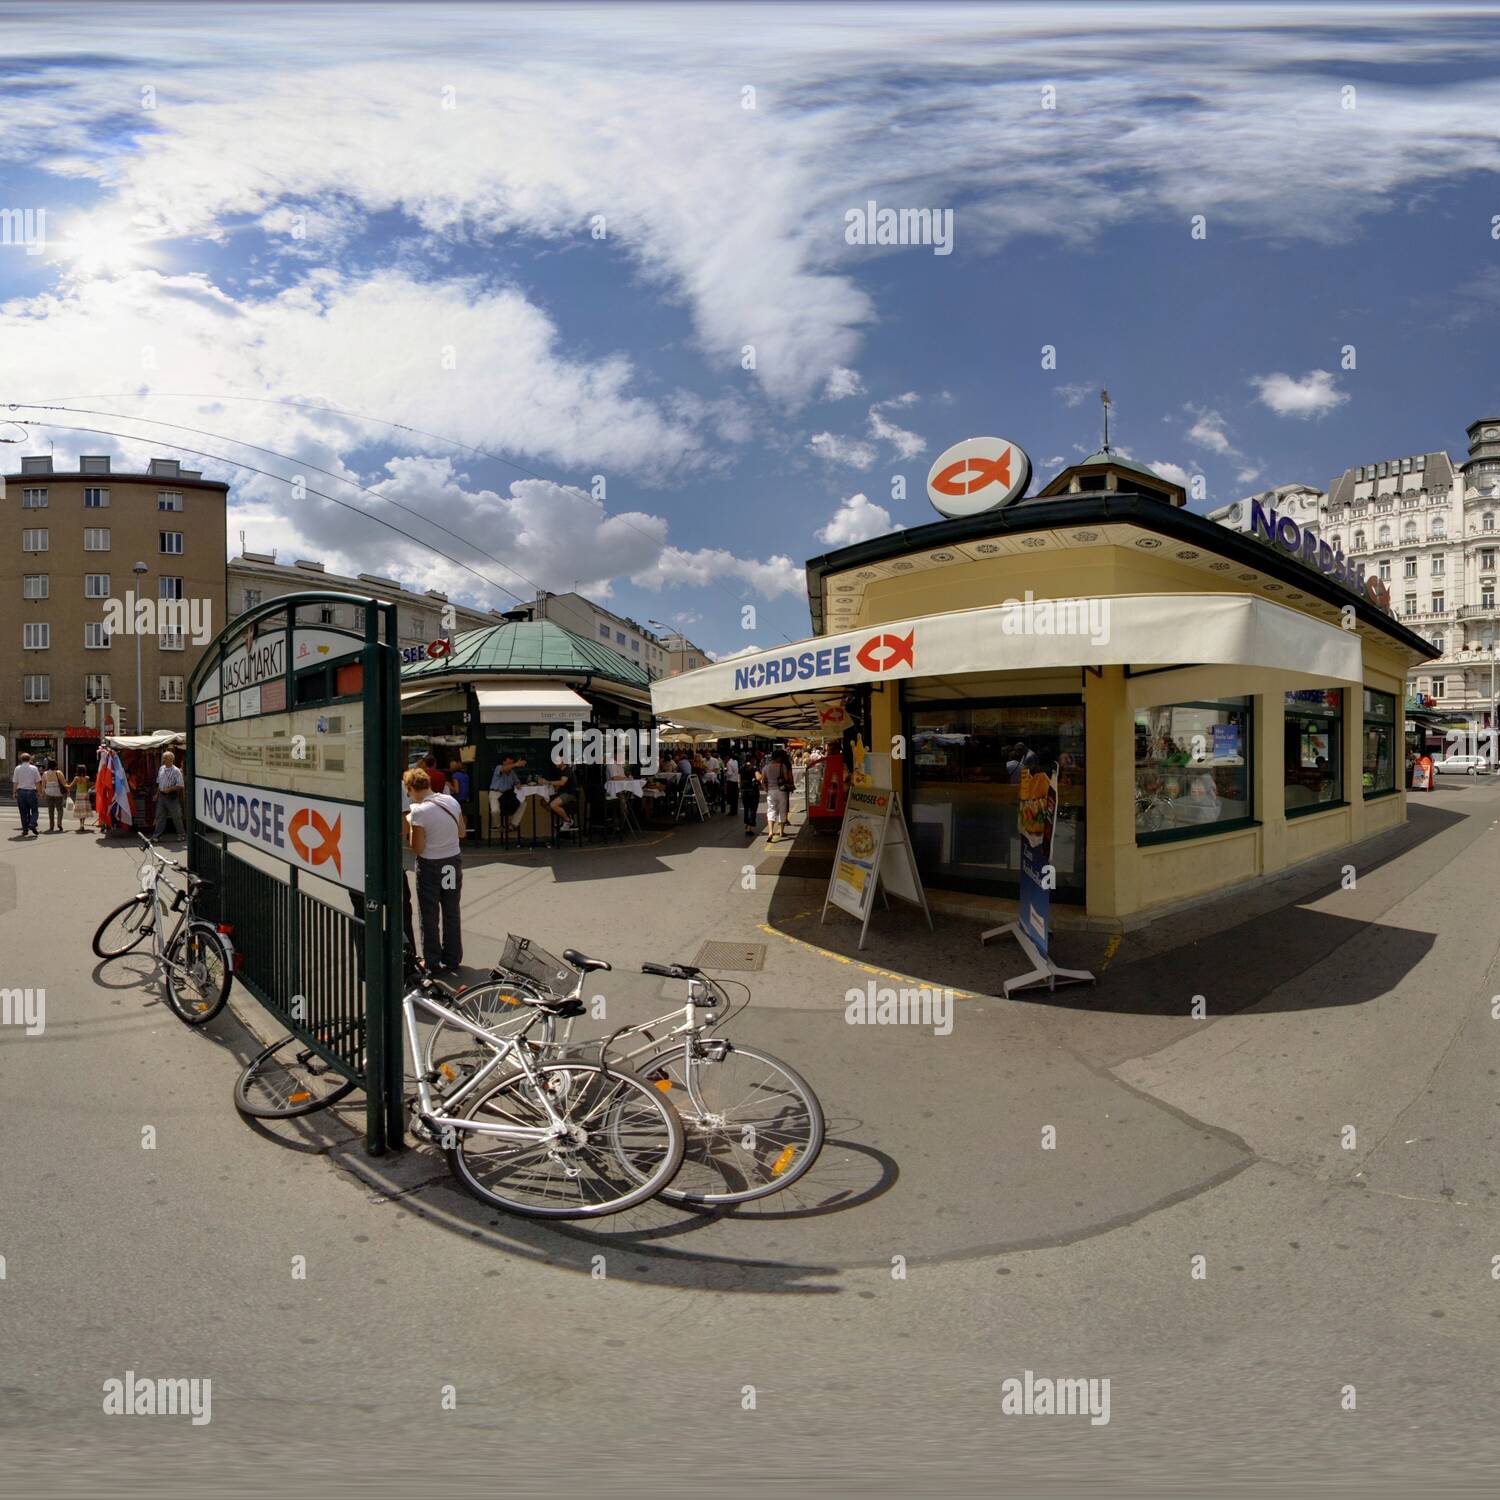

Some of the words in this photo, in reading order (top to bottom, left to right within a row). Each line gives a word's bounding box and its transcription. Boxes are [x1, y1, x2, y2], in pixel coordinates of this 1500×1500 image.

[1251, 498, 1366, 595] NORDSEE
[735, 645, 851, 690] NORDSEE
[203, 787, 285, 849] NORDSEE
[851, 792, 877, 805] NORDSEE
